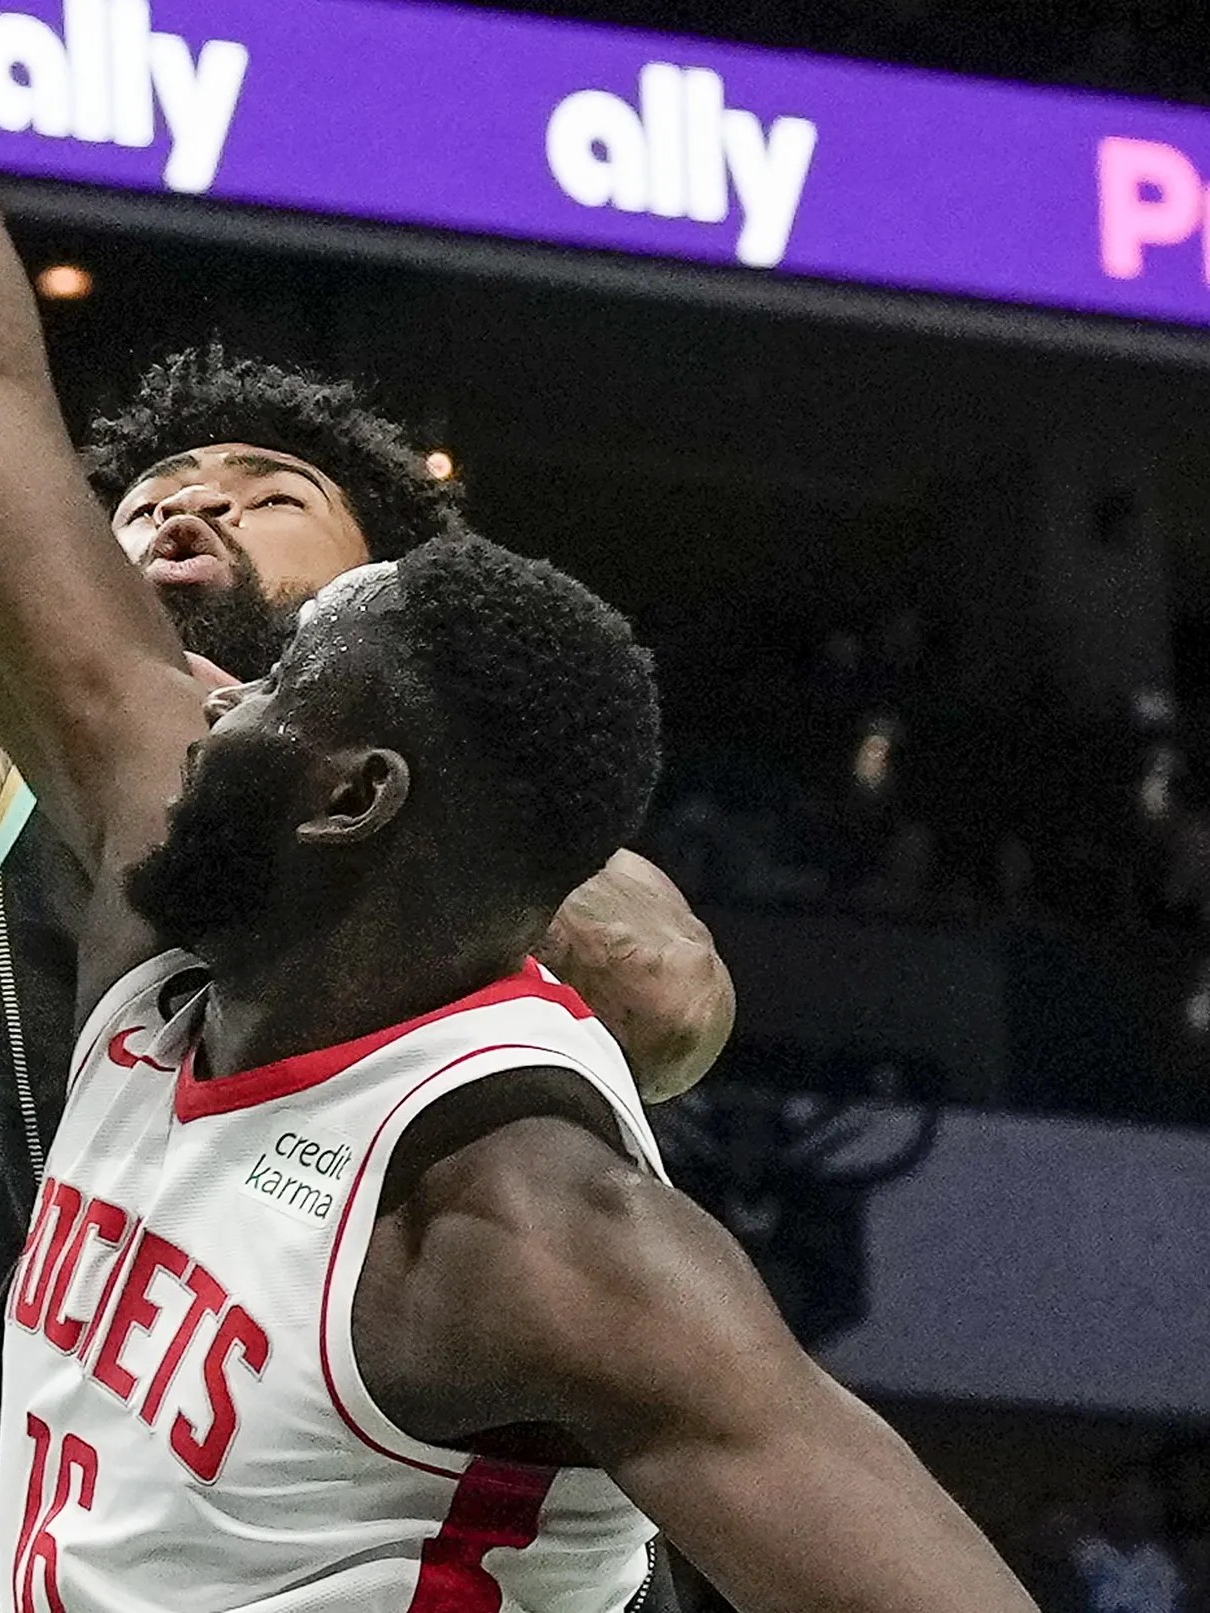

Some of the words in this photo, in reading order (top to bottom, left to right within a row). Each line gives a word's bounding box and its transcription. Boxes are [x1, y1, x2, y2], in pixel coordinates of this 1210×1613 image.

[546, 61, 817, 268] ally
[1097, 136, 1210, 288] P
[245, 1153, 333, 1220] karma
[275, 1132, 352, 1181] credit
